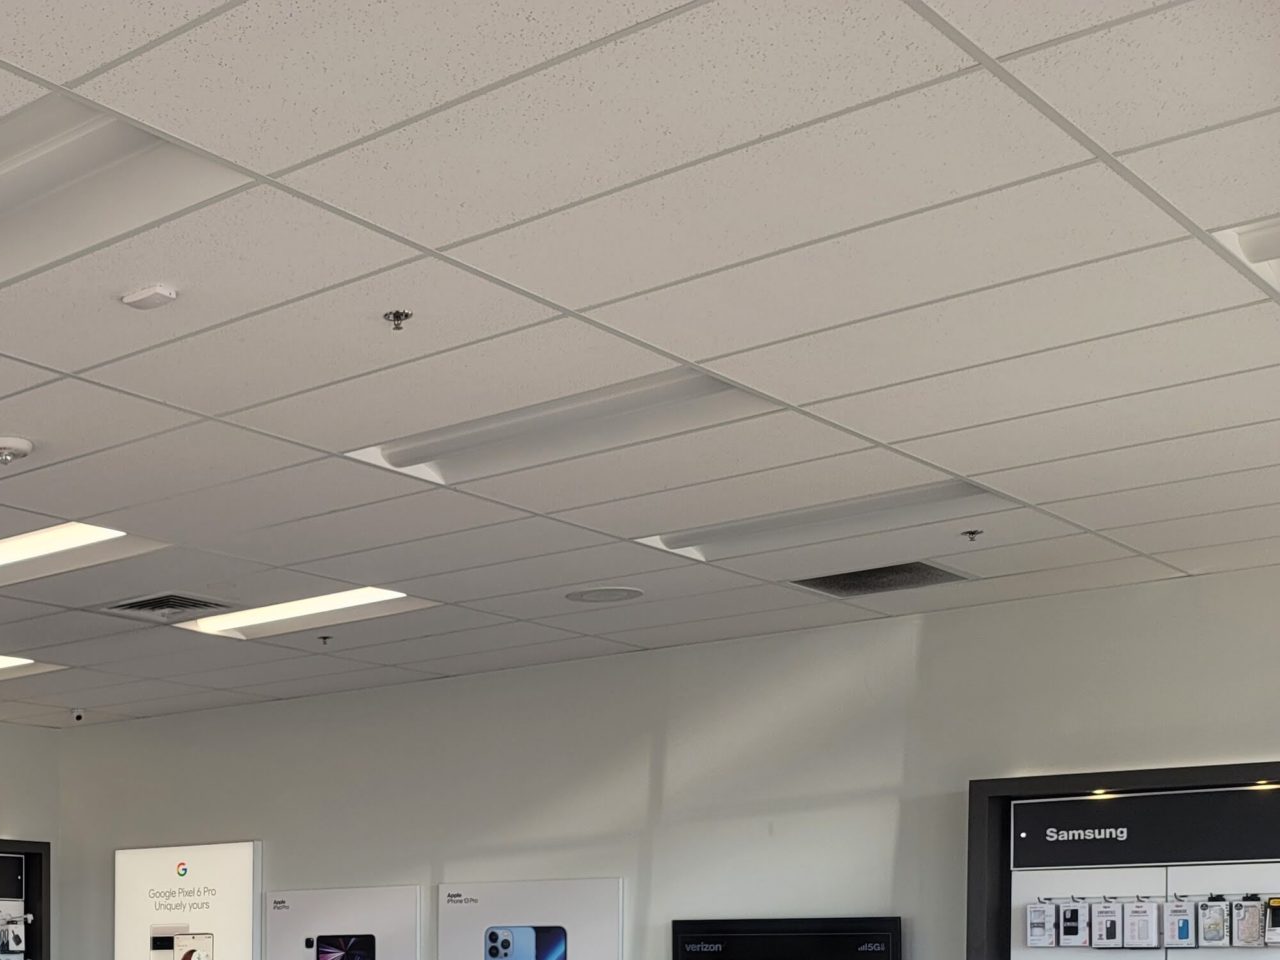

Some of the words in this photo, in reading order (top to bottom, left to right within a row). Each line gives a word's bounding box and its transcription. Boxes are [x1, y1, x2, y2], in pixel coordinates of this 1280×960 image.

[1045, 827, 1127, 841] Samsung
[148, 888, 177, 900] Google
[178, 887, 195, 897] Pixel
[196, 888, 201, 897] 6
[203, 886, 216, 896] Pro
[154, 901, 187, 912] Uniquely
[188, 901, 210, 912] yours
[685, 942, 722, 952] verizon
